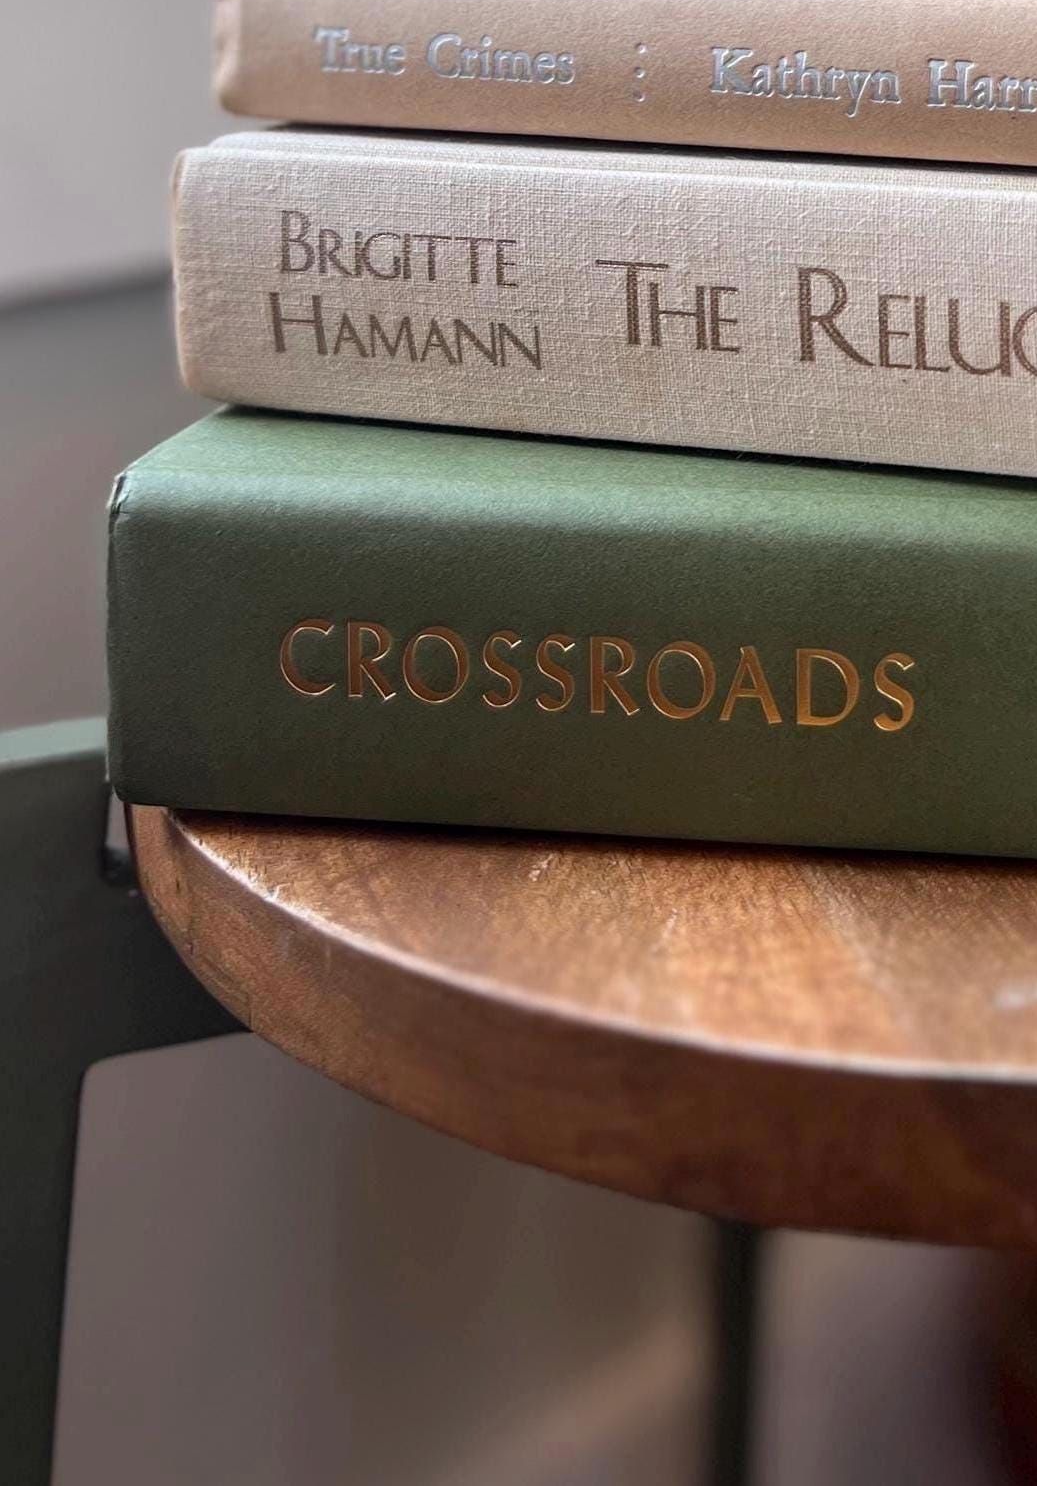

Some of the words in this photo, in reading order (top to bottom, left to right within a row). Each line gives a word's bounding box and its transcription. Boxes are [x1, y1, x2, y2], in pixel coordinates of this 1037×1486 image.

[313, 26, 406, 74] True
[426, 34, 575, 86] Crimes
[709, 47, 901, 117] Kathryn
[279, 618, 917, 732] CROSSROADS
